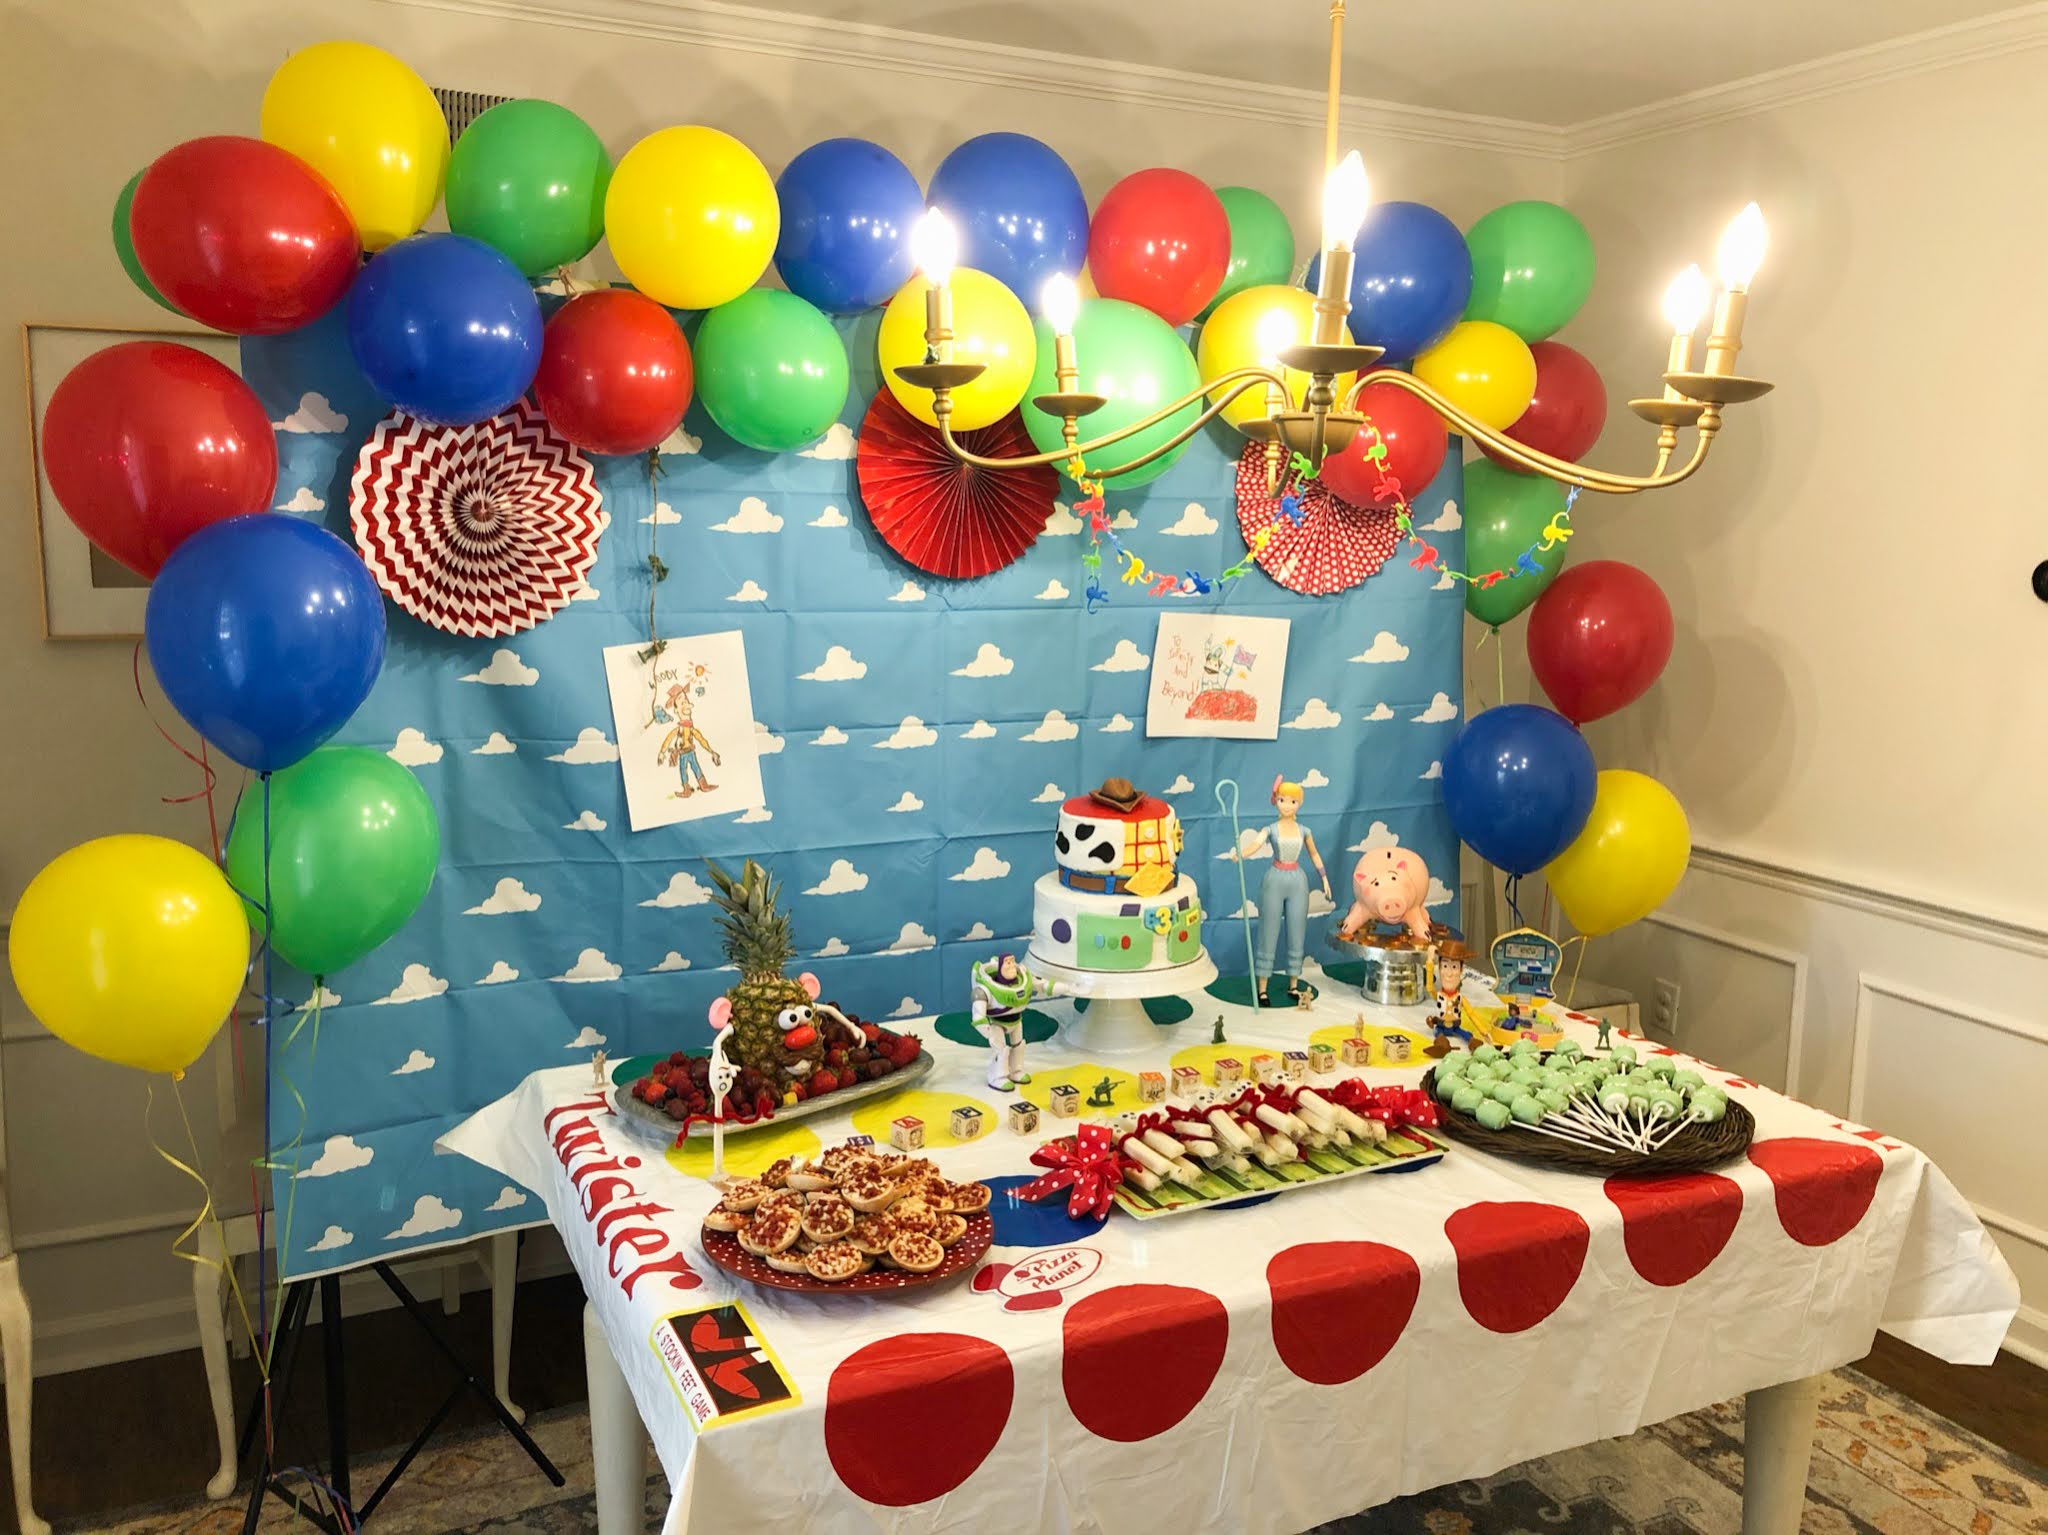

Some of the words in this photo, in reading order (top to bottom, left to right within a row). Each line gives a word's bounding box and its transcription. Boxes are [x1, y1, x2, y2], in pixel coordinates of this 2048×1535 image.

[1155, 905, 1172, 936] 3
[544, 1091, 703, 1302] Twister
[1019, 1260, 1083, 1290] Planet
[1022, 1251, 1078, 1274] Pizza
[656, 1326, 665, 1339] A
[660, 1334, 686, 1373] STOCKIN'
[679, 1369, 697, 1395] FEET
[690, 1392, 711, 1423] GAME
